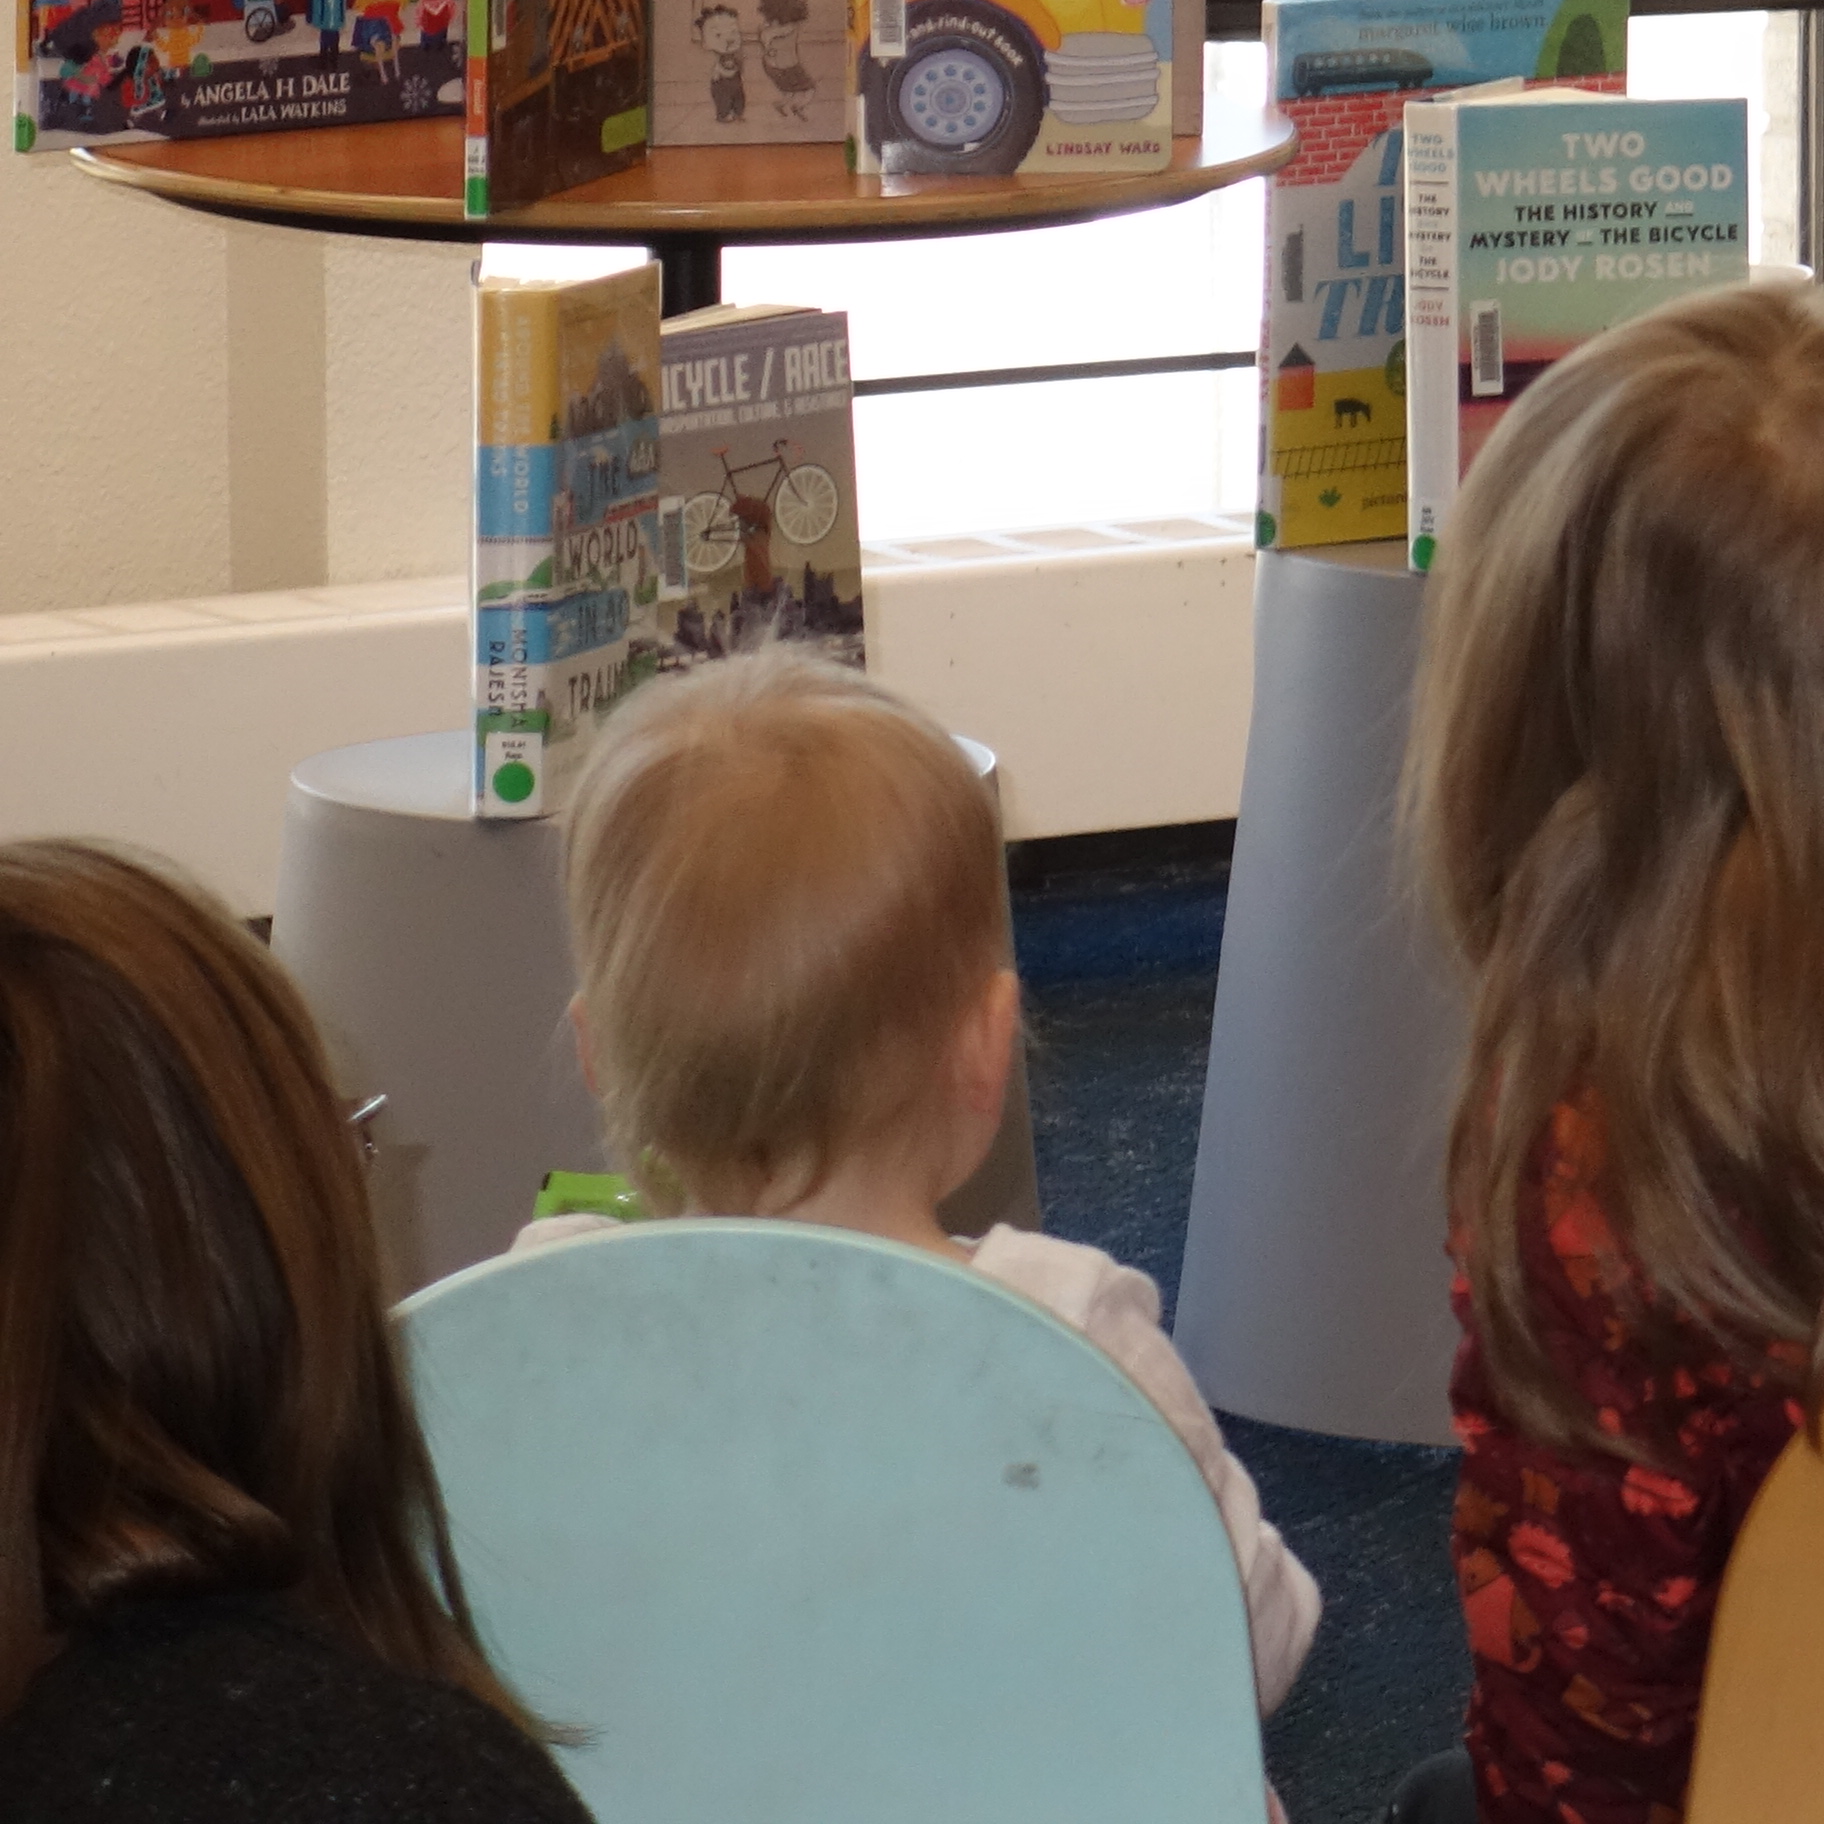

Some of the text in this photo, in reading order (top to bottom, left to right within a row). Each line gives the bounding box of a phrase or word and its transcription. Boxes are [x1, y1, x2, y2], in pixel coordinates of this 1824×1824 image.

[193, 80, 270, 107] ANGELA
[275, 77, 295, 100] H
[302, 72, 351, 97] DALE
[240, 105, 278, 124] LALA
[279, 98, 348, 120] WATKINS
[1045, 137, 1161, 157] LINDSAY WARD
[1561, 130, 1646, 160] TWO
[1474, 163, 1734, 198] WHEELS GOOD
[1515, 203, 1555, 223] THE
[1563, 201, 1659, 222] HISTORY
[1469, 229, 1571, 250] MYSTERY
[1600, 227, 1641, 246] THE
[1650, 223, 1739, 244] BICYCLE
[1496, 251, 1711, 285] JODY ROSEN
[661, 353, 751, 412] ICYCLE
[783, 339, 849, 393] RACE
[487, 639, 506, 718] RAJESH
[510, 628, 528, 729] MONISHA
